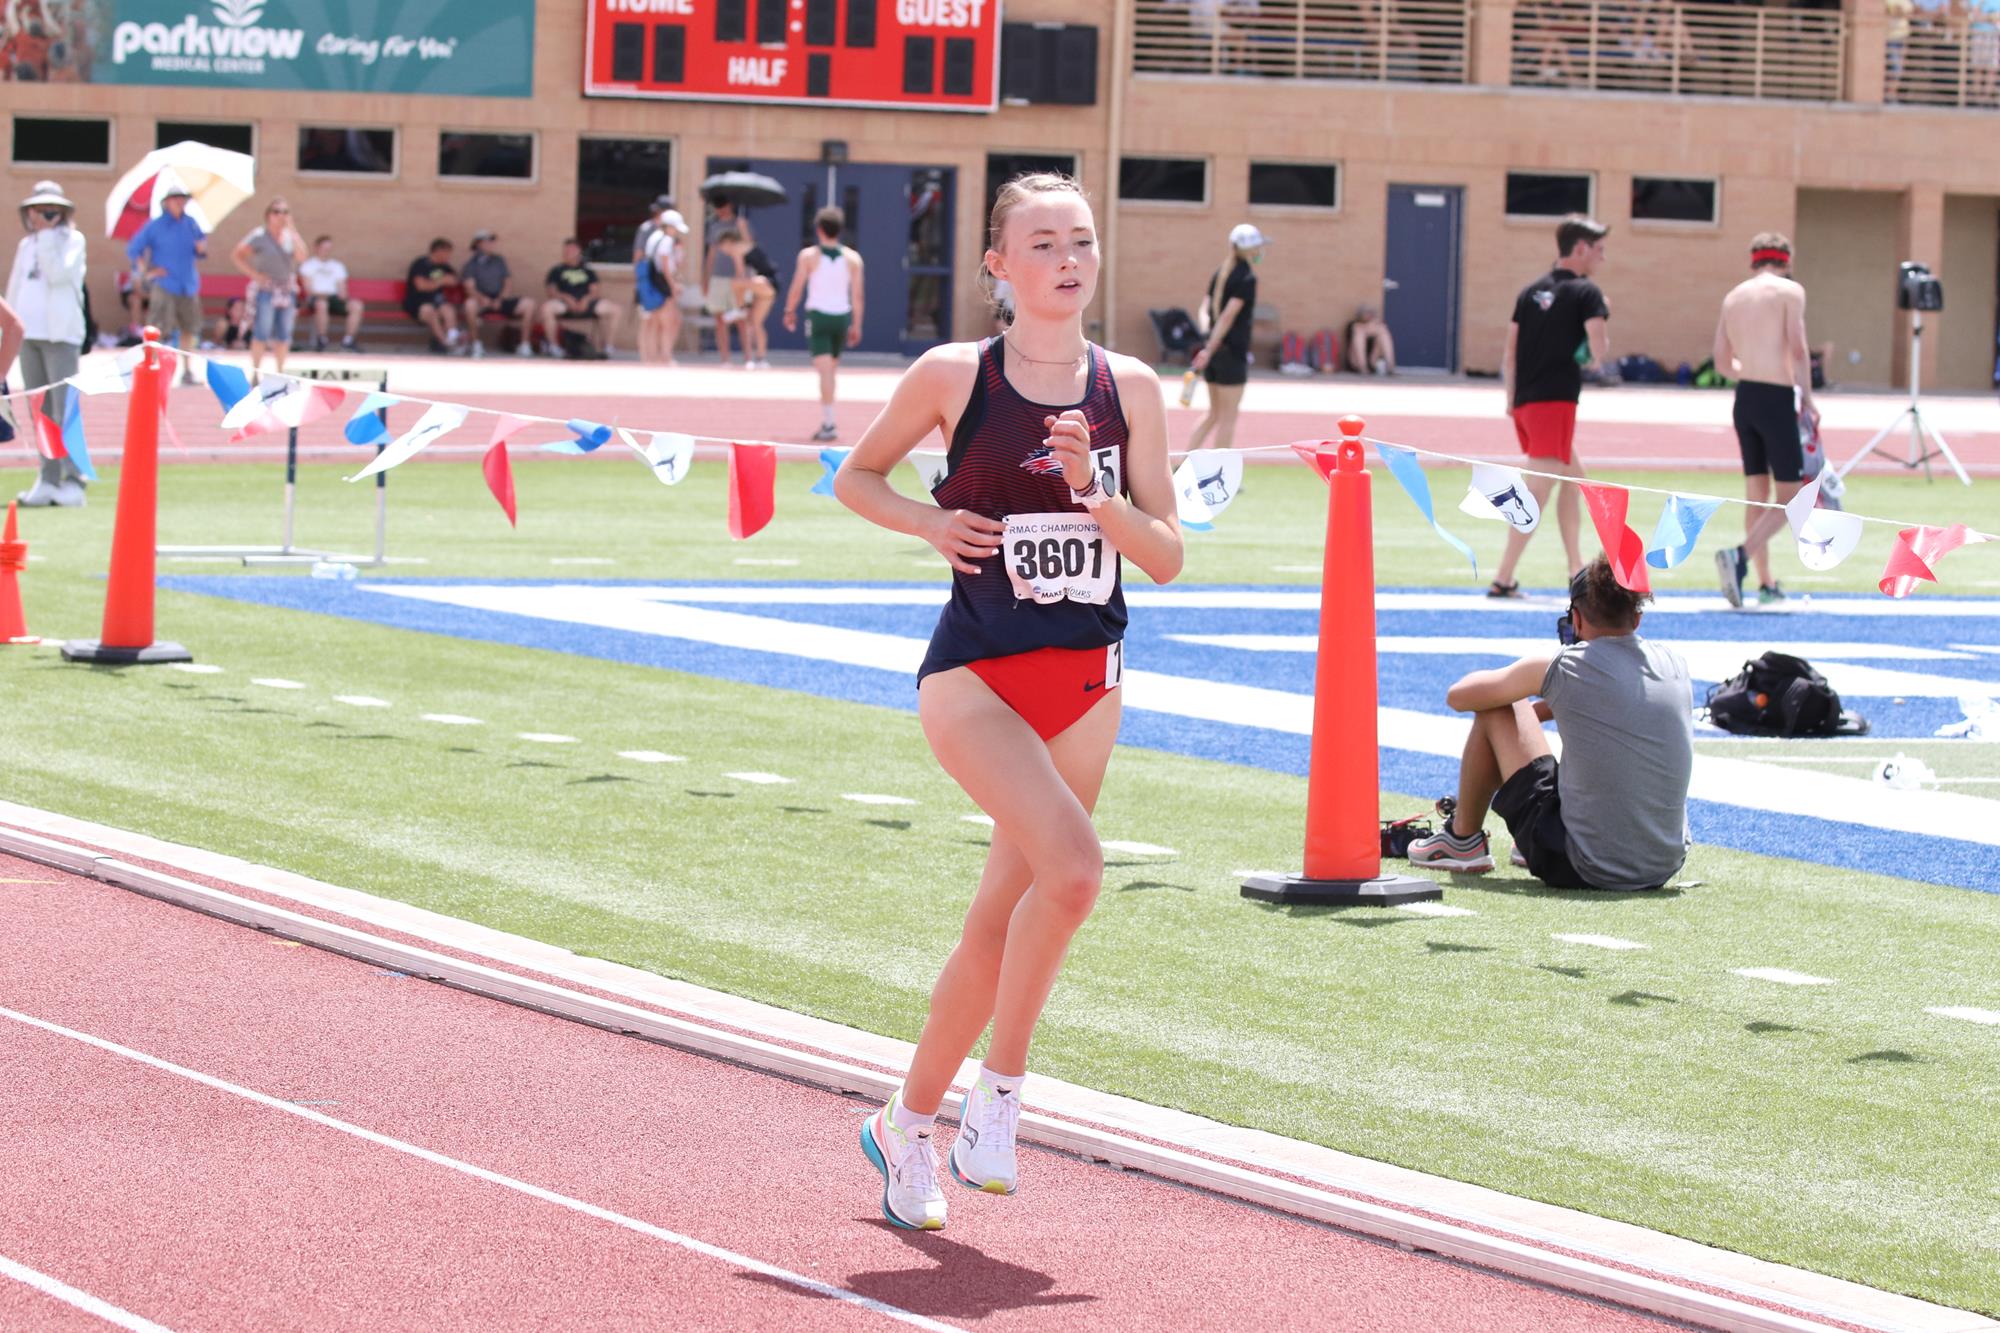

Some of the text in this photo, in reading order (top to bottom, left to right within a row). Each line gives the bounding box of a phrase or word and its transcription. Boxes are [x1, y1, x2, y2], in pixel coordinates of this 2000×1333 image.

[896, 0, 986, 28] GUEST
[113, 14, 304, 64] parkview
[316, 32, 454, 65] Caring For You
[151, 56, 265, 74] MEDICAL CENTER
[728, 56, 788, 86] HALF
[1009, 525, 1038, 535] RMAC
[1013, 538, 1103, 580] 3601
